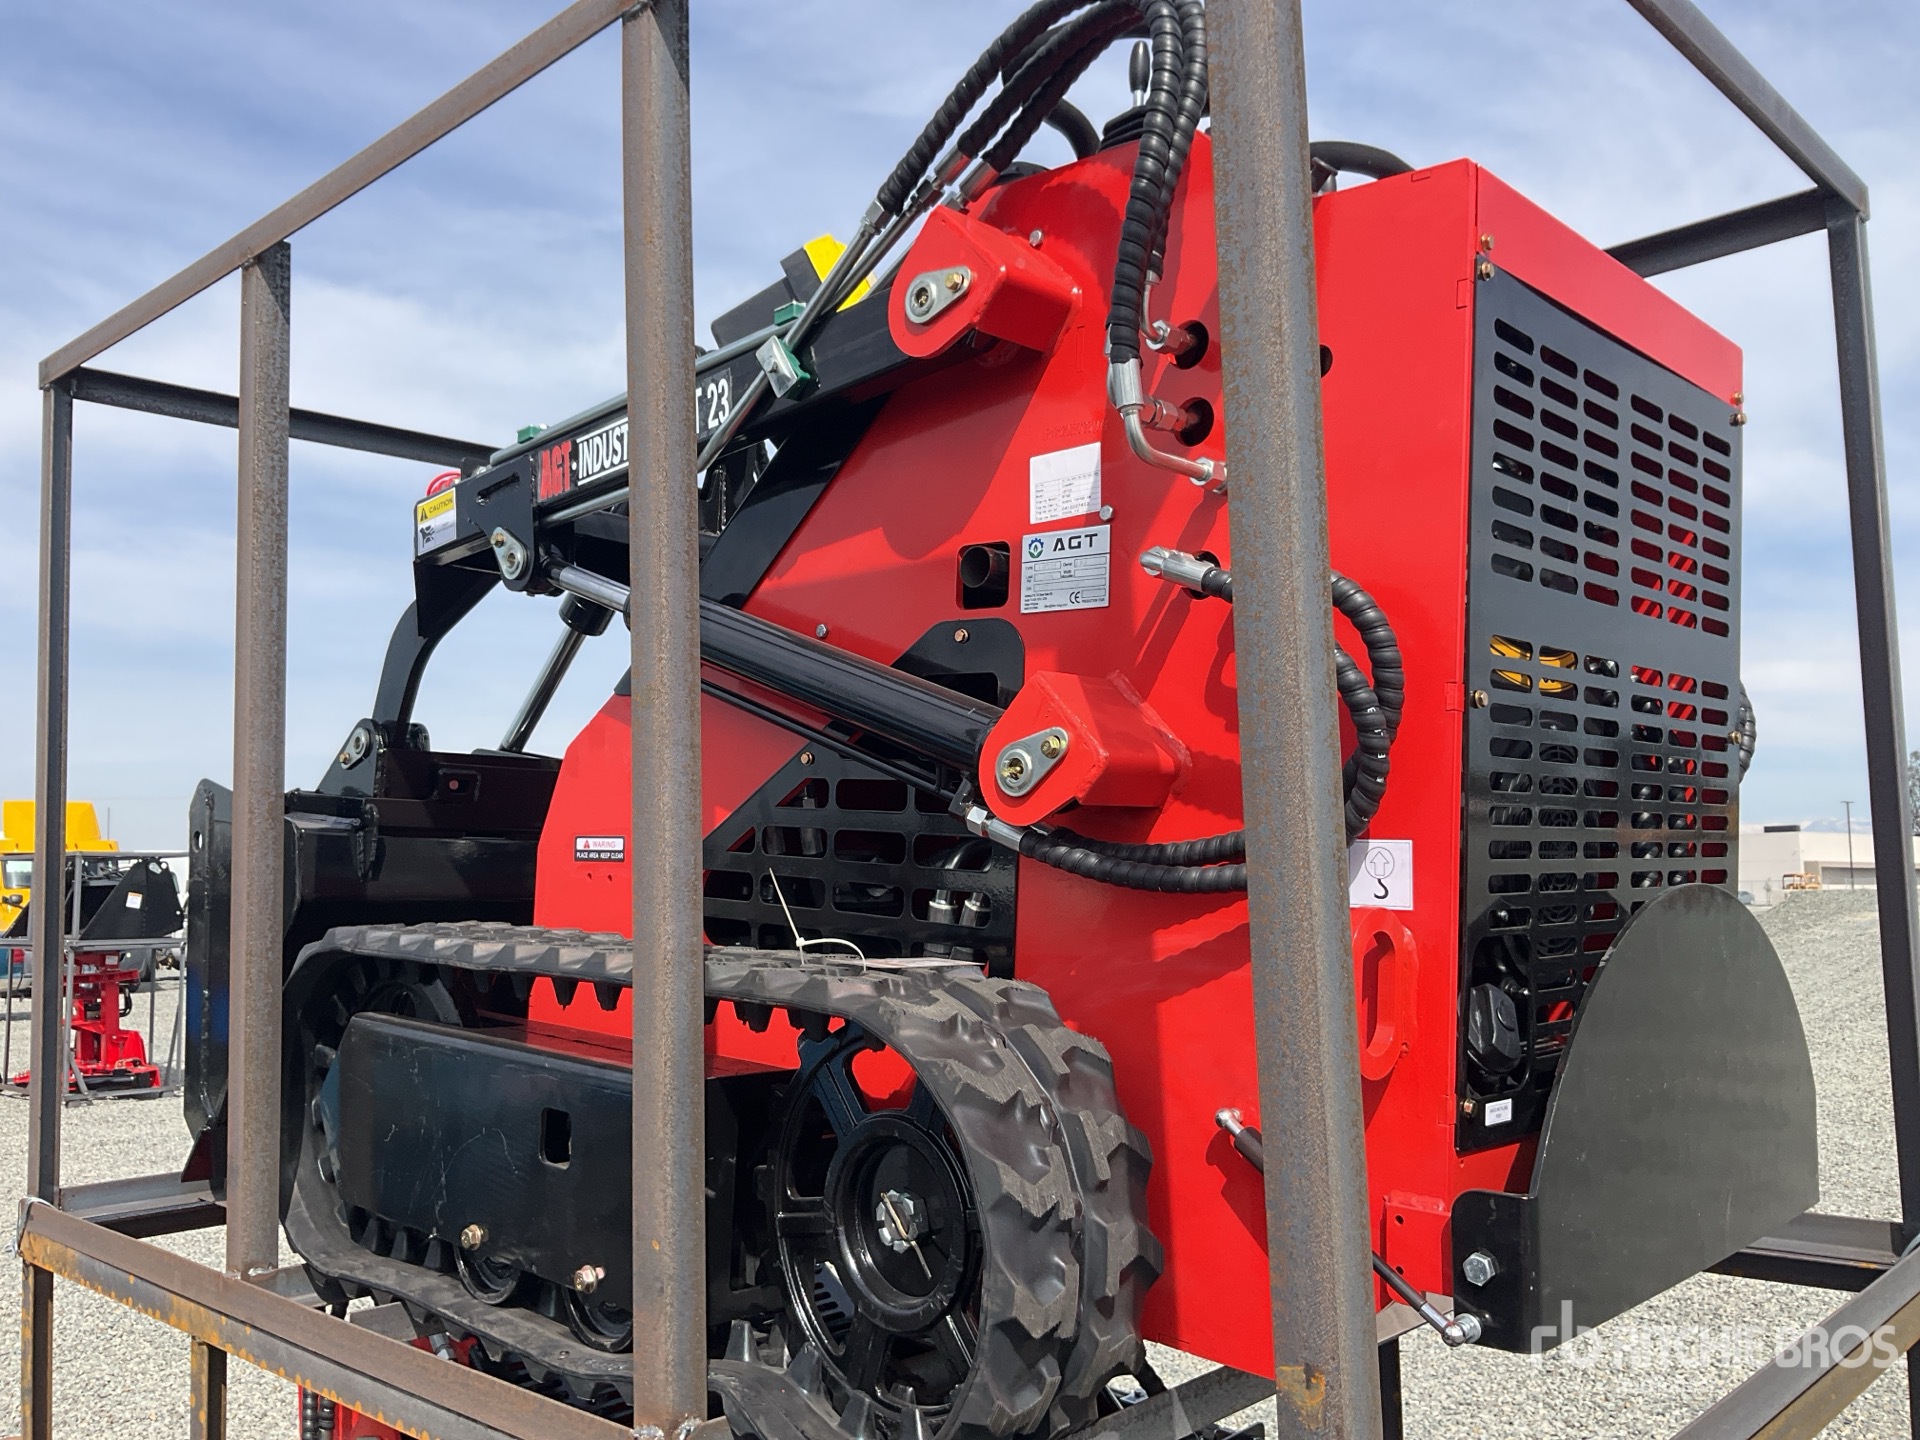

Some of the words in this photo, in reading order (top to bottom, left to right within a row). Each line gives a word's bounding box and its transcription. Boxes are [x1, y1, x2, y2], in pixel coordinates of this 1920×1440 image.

[540, 440, 571, 500] AGT
[578, 423, 629, 479] INDUST
[707, 378, 730, 429] 23
[428, 496, 454, 514] CAUTION
[1053, 533, 1098, 552] AGT
